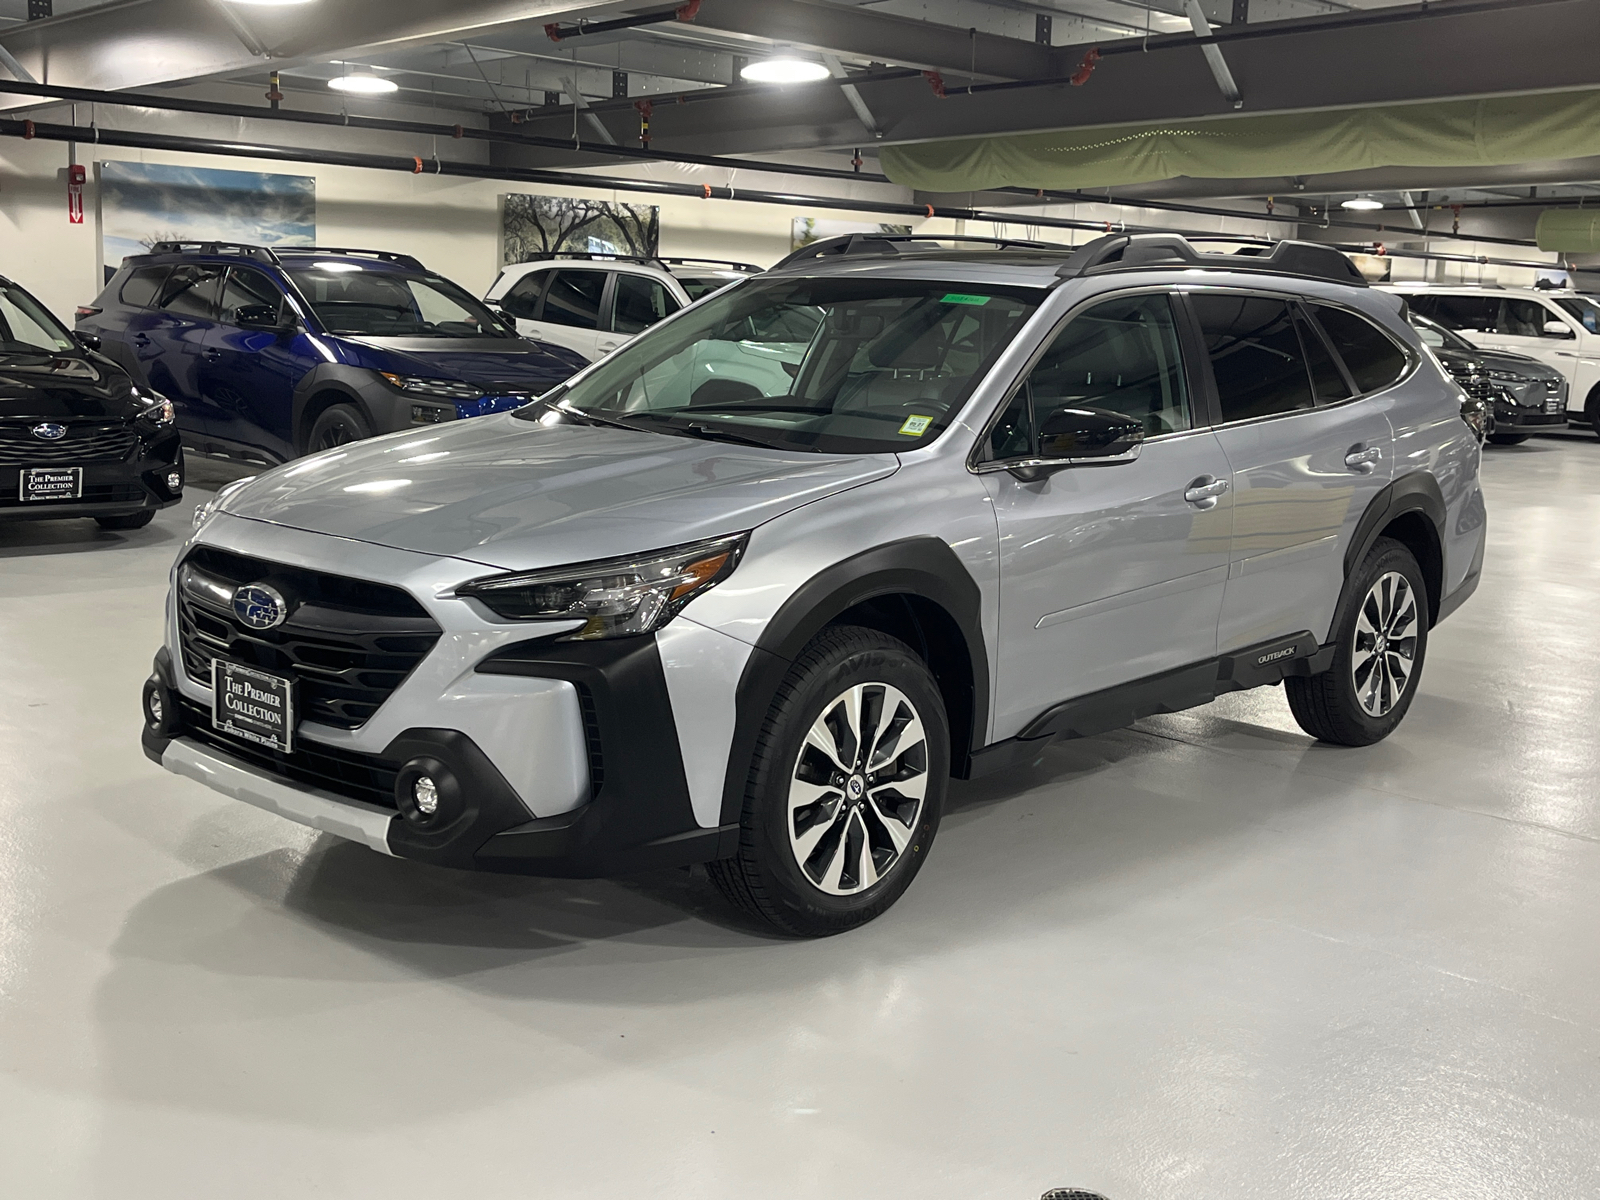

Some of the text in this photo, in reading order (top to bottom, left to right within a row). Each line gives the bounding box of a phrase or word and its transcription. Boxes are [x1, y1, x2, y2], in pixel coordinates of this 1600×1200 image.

[28, 482, 73, 490] COLLECTION
[45, 474, 74, 482] PREMIER
[1258, 646, 1295, 664] OUTBACK
[224, 676, 281, 708] THE PREMIER
[225, 693, 282, 725] COLLECTION
